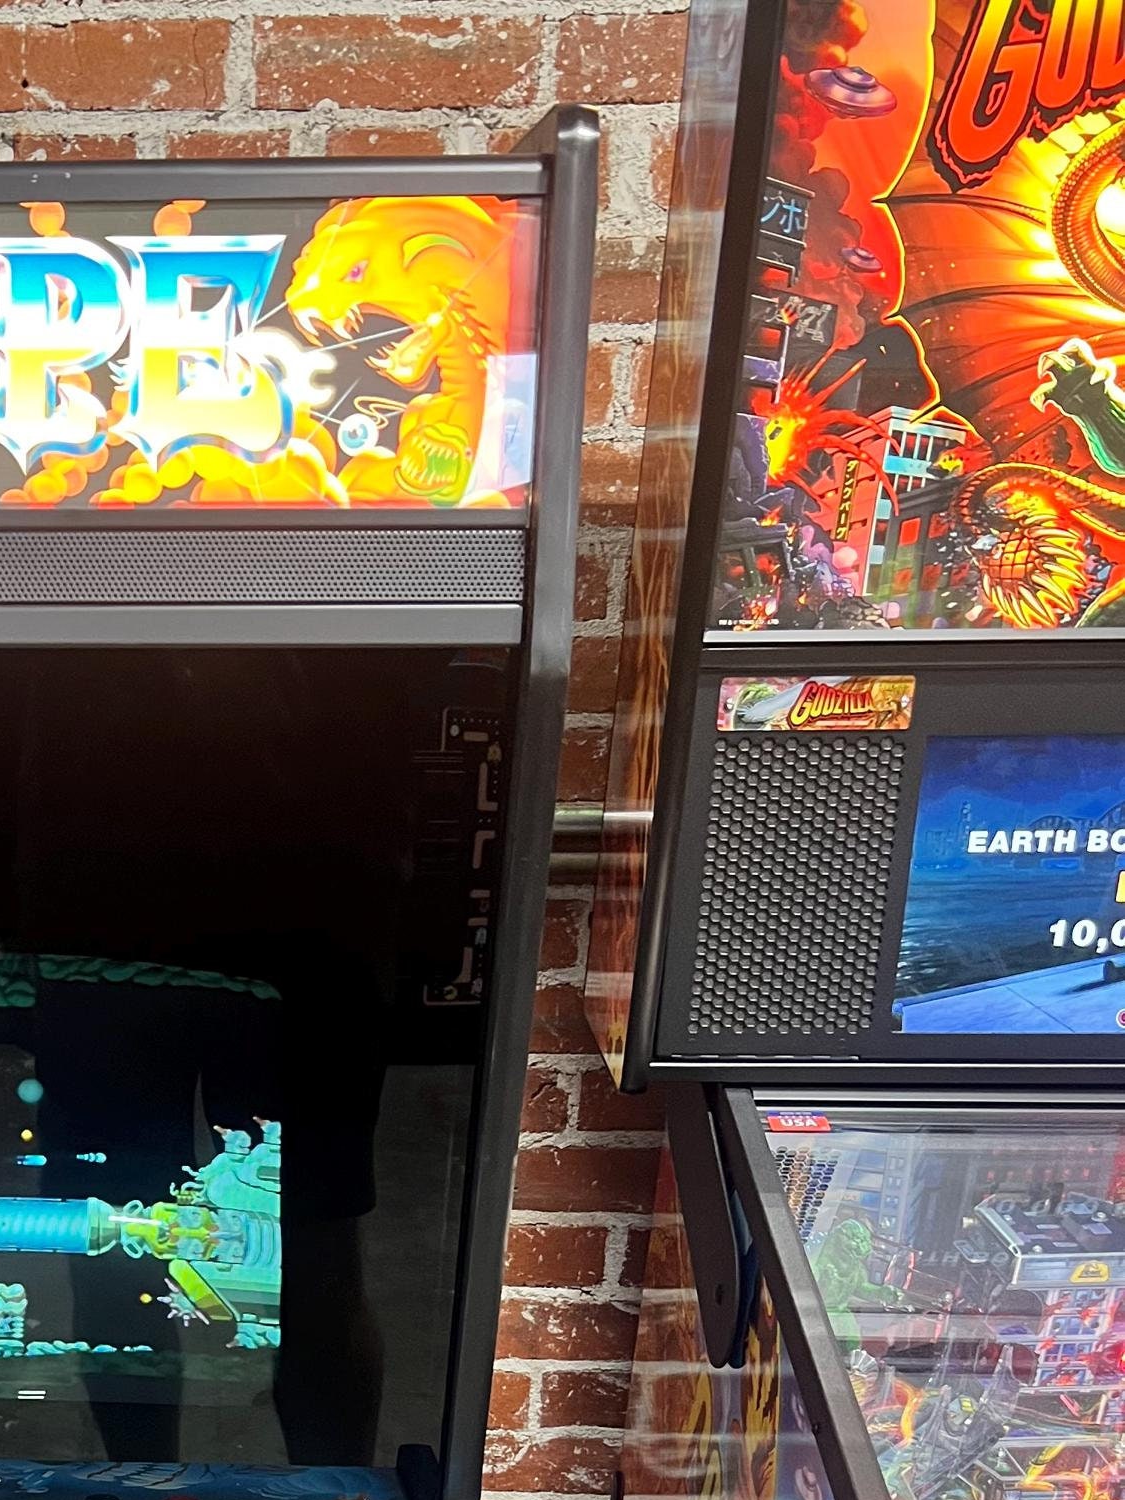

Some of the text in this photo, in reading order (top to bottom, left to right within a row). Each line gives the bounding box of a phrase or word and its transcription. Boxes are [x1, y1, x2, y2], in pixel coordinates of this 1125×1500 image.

[790, 681, 874, 725] GODZILLA
[968, 829, 1076, 852] EARTH
[780, 1118, 818, 1127] USA
